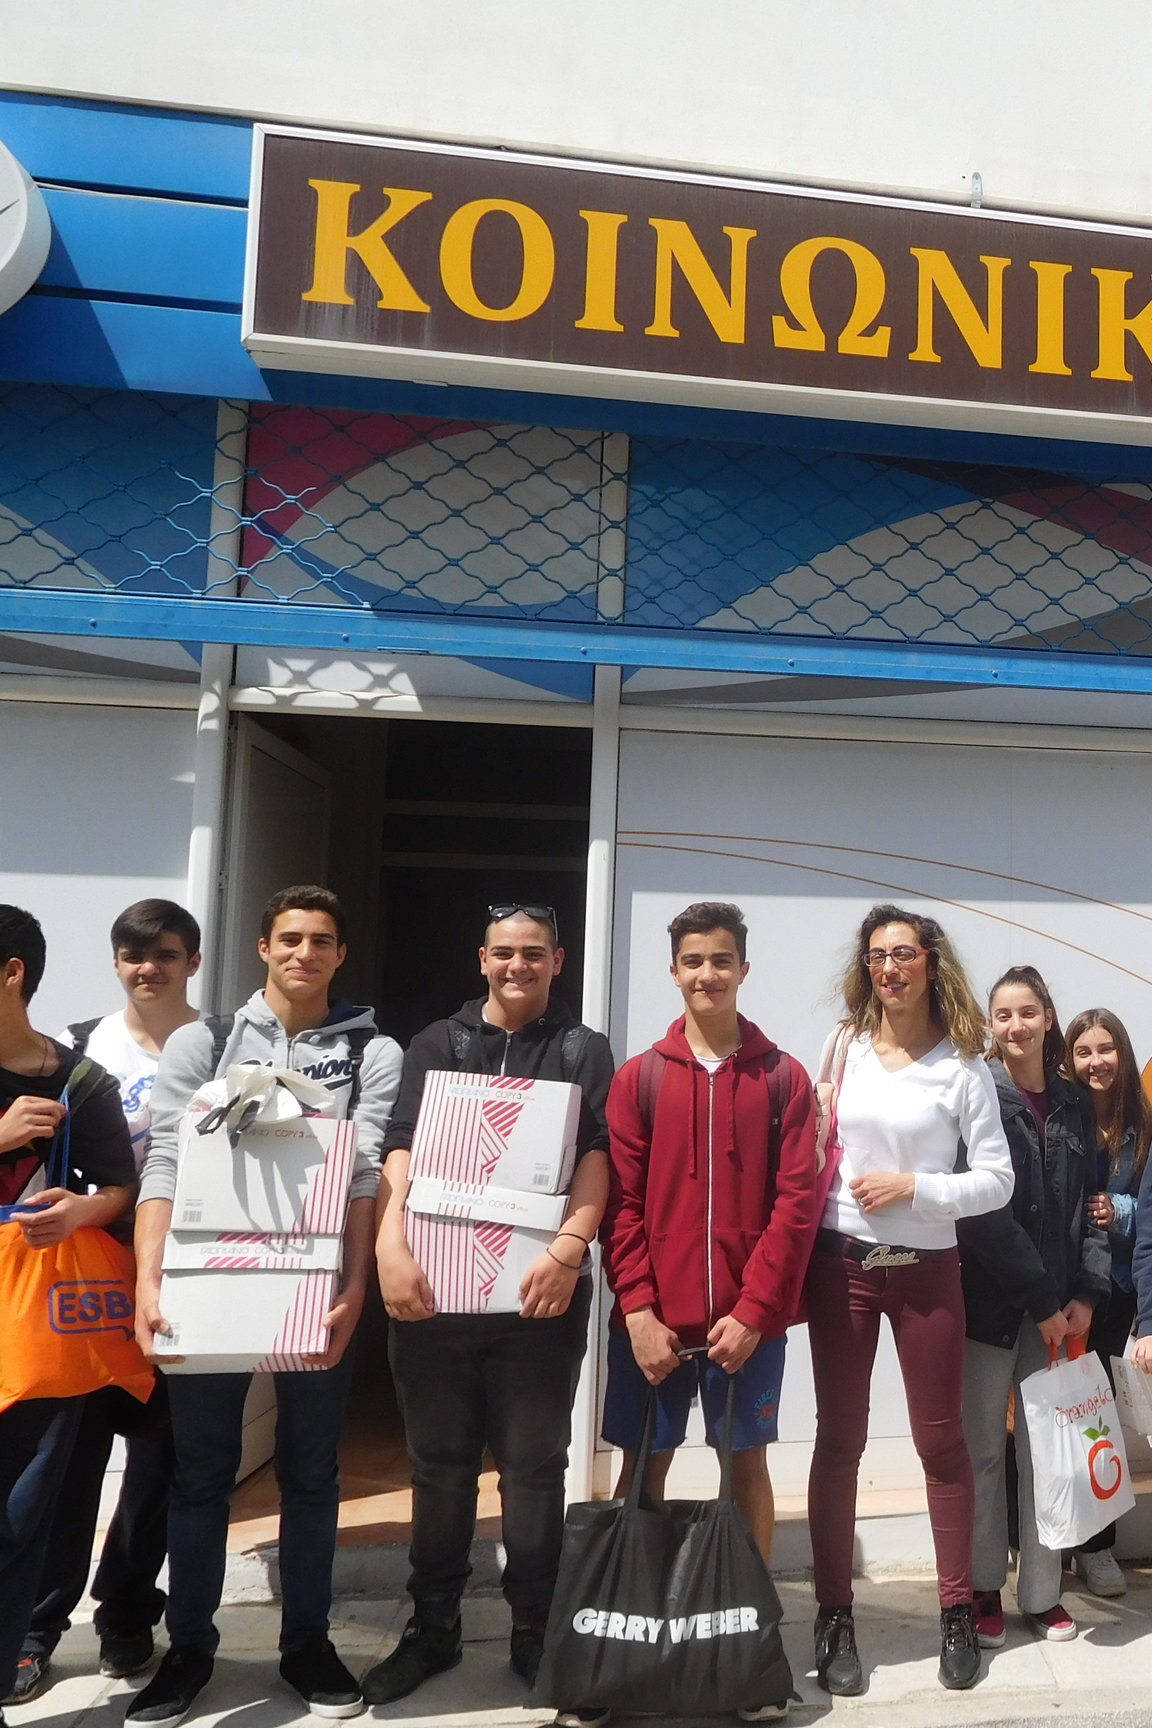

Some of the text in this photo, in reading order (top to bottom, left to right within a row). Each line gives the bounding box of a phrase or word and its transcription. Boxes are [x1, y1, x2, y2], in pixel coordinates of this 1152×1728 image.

[57, 1290, 134, 1324] ESB
[572, 1606, 760, 1644] GERRY WEBER
